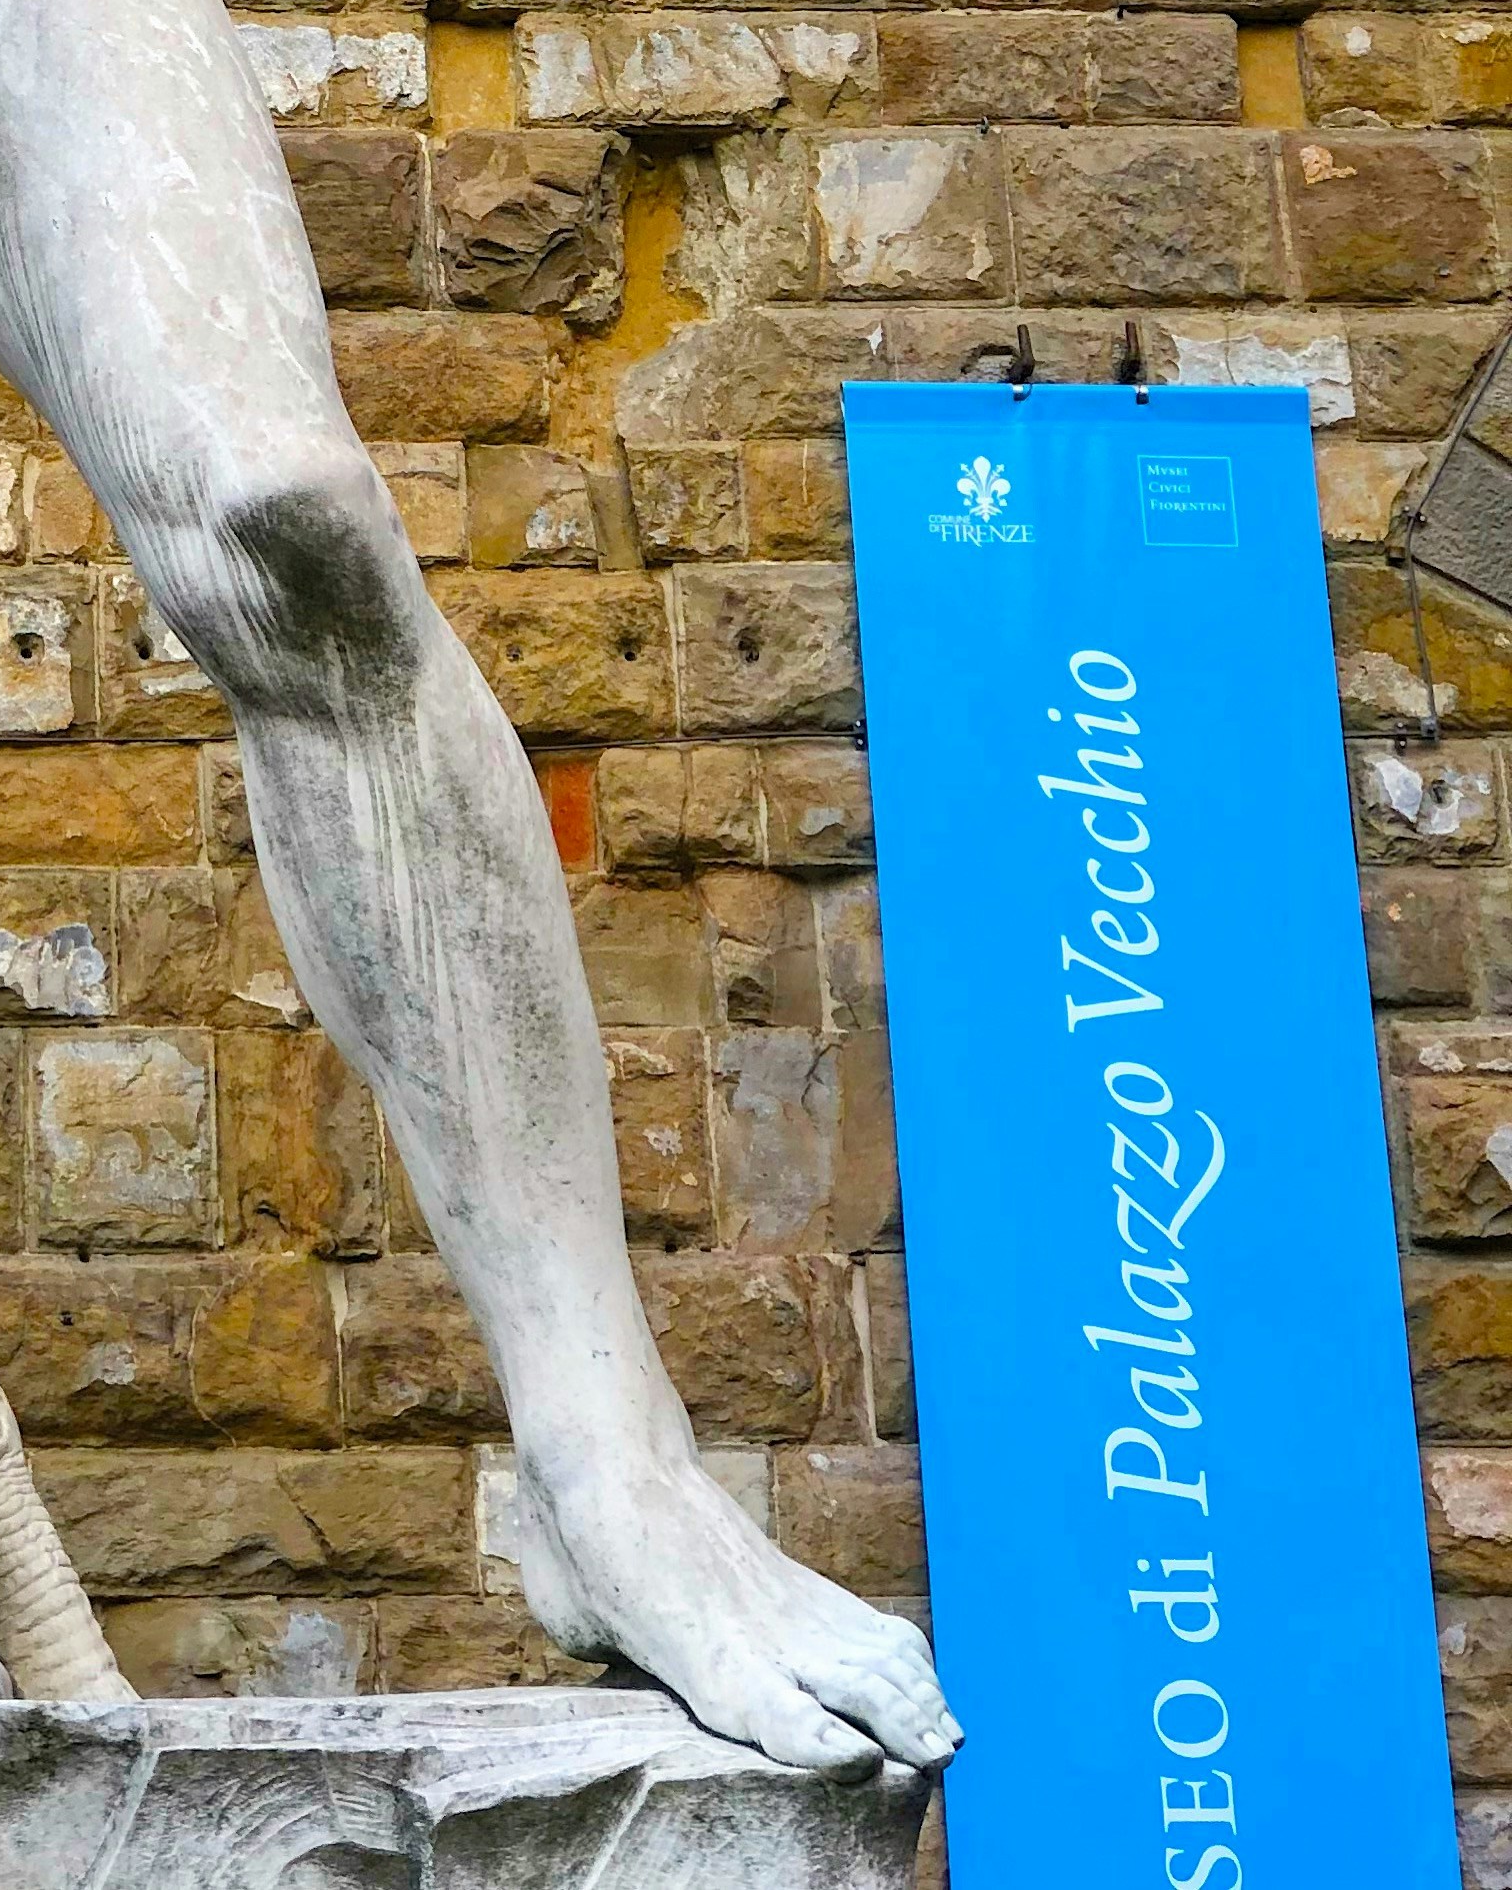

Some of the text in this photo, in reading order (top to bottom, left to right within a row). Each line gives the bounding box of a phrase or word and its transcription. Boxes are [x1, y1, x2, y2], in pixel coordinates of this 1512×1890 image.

[928, 514, 971, 525] COMUNE
[941, 524, 1036, 548] FIRENZE
[1038, 650, 1243, 1890] SEO di Palazzo Vecchio
